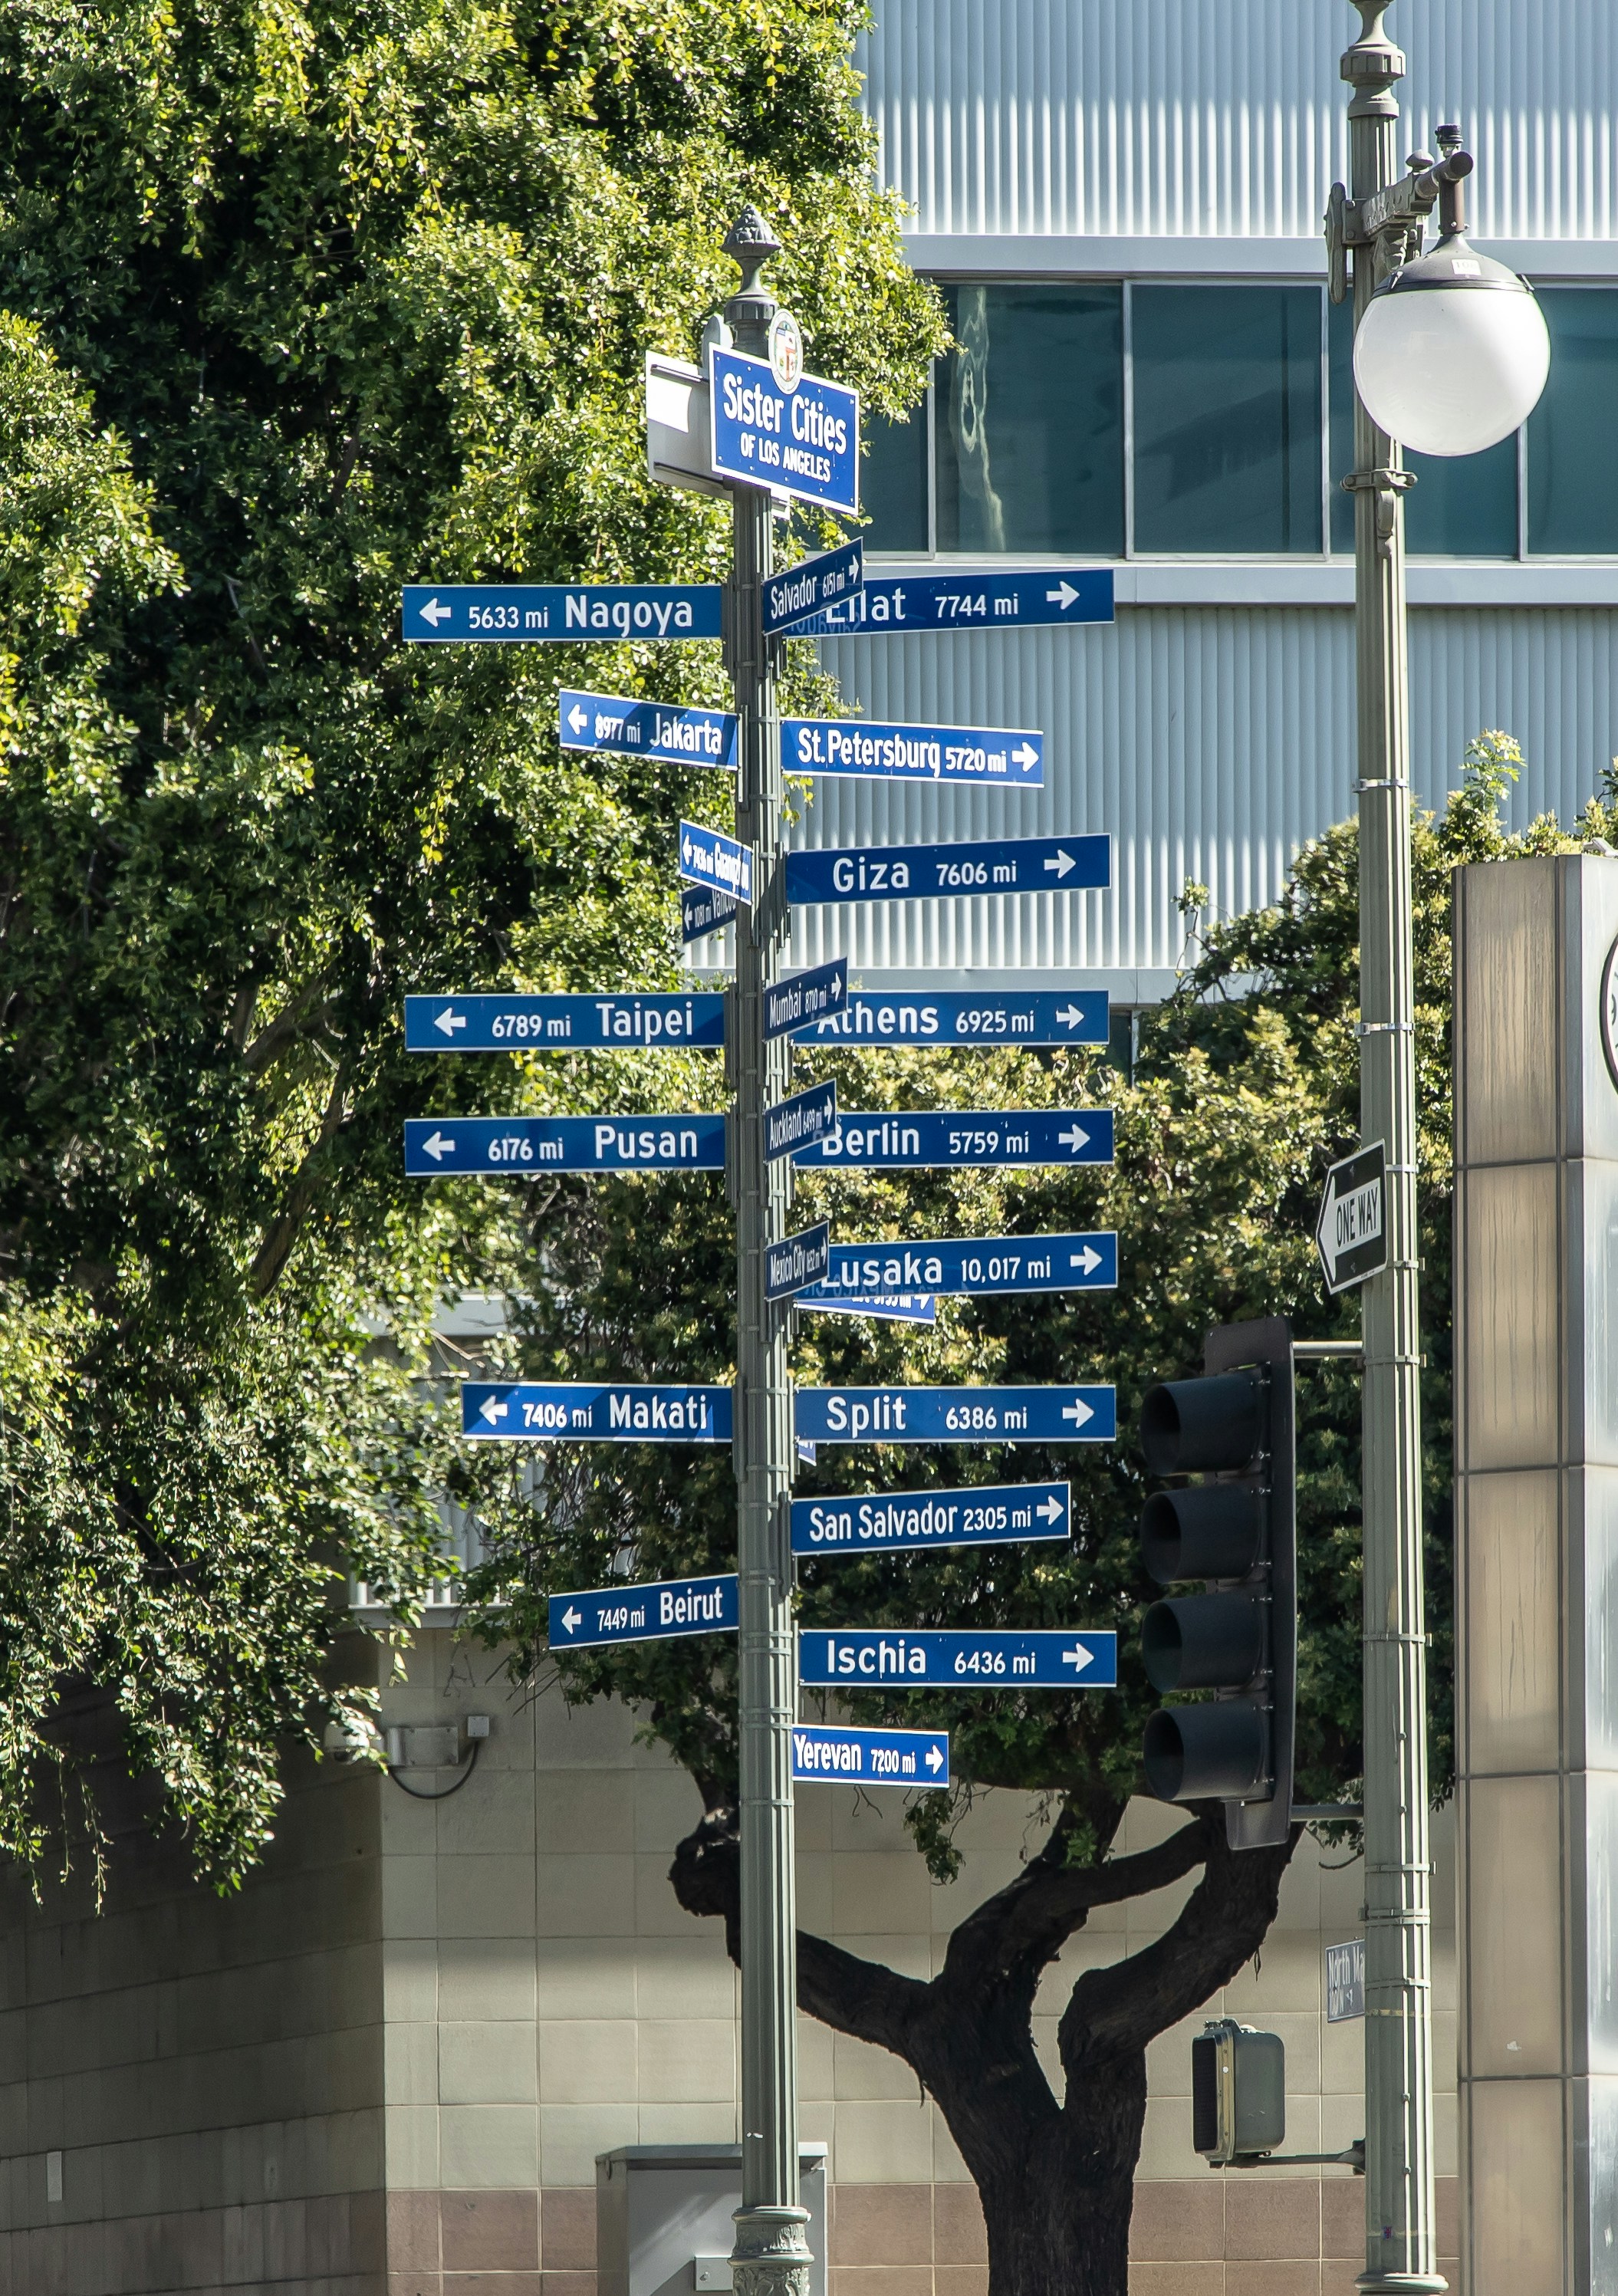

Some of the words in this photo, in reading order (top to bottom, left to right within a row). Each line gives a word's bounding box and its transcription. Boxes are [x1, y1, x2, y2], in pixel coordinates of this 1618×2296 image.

[723, 372, 784, 435] Sister
[791, 395, 846, 455] Cities
[741, 433, 755, 458] OF
[759, 438, 780, 466] LOS
[783, 445, 831, 482] ANGELES
[771, 574, 817, 620] Salvador
[823, 572, 835, 597] 6151
[837, 567, 844, 591] mi
[936, 595, 986, 617] 7744
[995, 594, 1018, 615] mi
[469, 607, 518, 628] 5633
[525, 607, 548, 628] mi
[564, 595, 693, 638] Nagoya
[595, 712, 623, 740] 8977
[627, 722, 640, 743] mi
[650, 712, 723, 755] Jakarta
[945, 747, 985, 771] 5720
[988, 751, 1006, 772] mi
[707, 852, 713, 874] mi
[834, 857, 909, 892] Giza
[936, 863, 988, 886] 7606
[993, 860, 1016, 883] mi
[492, 1015, 542, 1037] 6789
[548, 1015, 571, 1036] mi
[596, 1002, 692, 1044] Taipei
[770, 982, 801, 1029] Mumbai
[805, 988, 818, 1014] 8710
[819, 984, 827, 1008] mi
[956, 1011, 1006, 1033] 6925
[1012, 1011, 1034, 1032] mi
[488, 1138, 533, 1161] 6176
[540, 1137, 563, 1160] mi
[595, 1125, 697, 1159] Pusan
[770, 1103, 801, 1150] Auckland
[816, 1106, 822, 1129] mi
[821, 1120, 920, 1157] Berlin
[950, 1132, 998, 1156] 5759
[1007, 1131, 1028, 1153] mi
[1336, 1197, 1356, 1248] ONE
[1358, 1186, 1378, 1237] WAY
[770, 1250, 792, 1288] Mexico
[794, 1243, 806, 1284] City
[962, 1257, 1020, 1283] 10,017
[1028, 1255, 1050, 1278] mi
[522, 1403, 567, 1428] 7406
[572, 1406, 592, 1428] mi
[610, 1394, 706, 1429] Makati
[827, 1396, 906, 1439] Split
[946, 1406, 996, 1429] 6386
[1005, 1406, 1027, 1429] mi
[810, 1508, 851, 1541] San
[859, 1501, 958, 1538] Salvador
[964, 1507, 1007, 1531] 2305
[1012, 1505, 1031, 1528] mi
[597, 1607, 627, 1631] 7449
[631, 1605, 644, 1627] mi
[660, 1586, 722, 1624] Beirut
[827, 1638, 926, 1679] Ischia
[955, 1652, 1005, 1673] 6436
[1013, 1652, 1035, 1673] mi
[793, 1734, 862, 1771] Yerevan
[870, 1748, 900, 1774] 7200
[901, 1750, 916, 1775] mi
[1328, 1949, 1350, 1988] North
